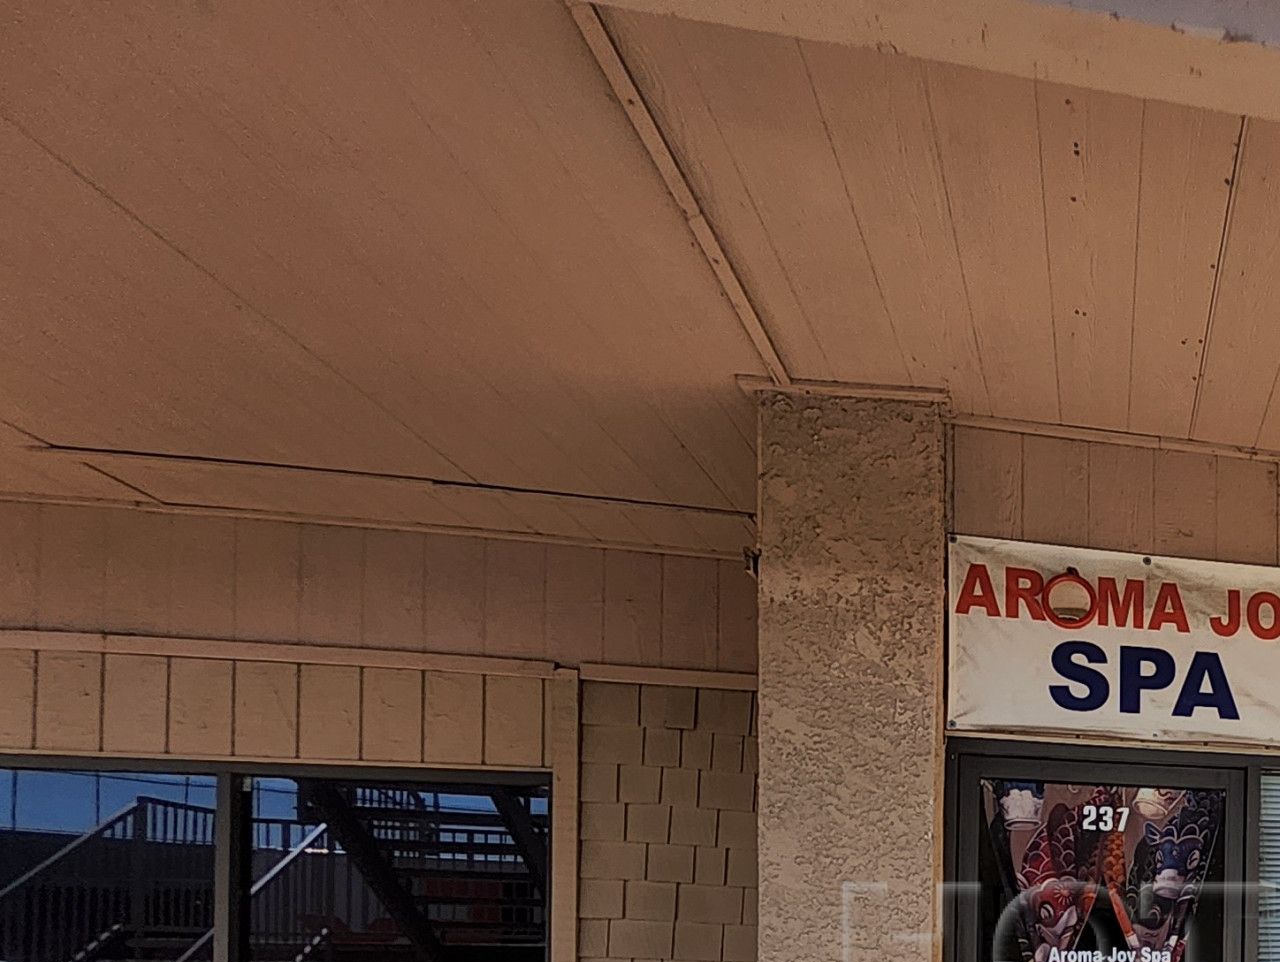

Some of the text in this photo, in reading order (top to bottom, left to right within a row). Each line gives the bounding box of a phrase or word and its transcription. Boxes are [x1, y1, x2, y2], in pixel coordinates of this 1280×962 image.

[955, 563, 1190, 634] AROMA
[1048, 640, 1240, 720] SPA
[1082, 805, 1130, 832] 237
